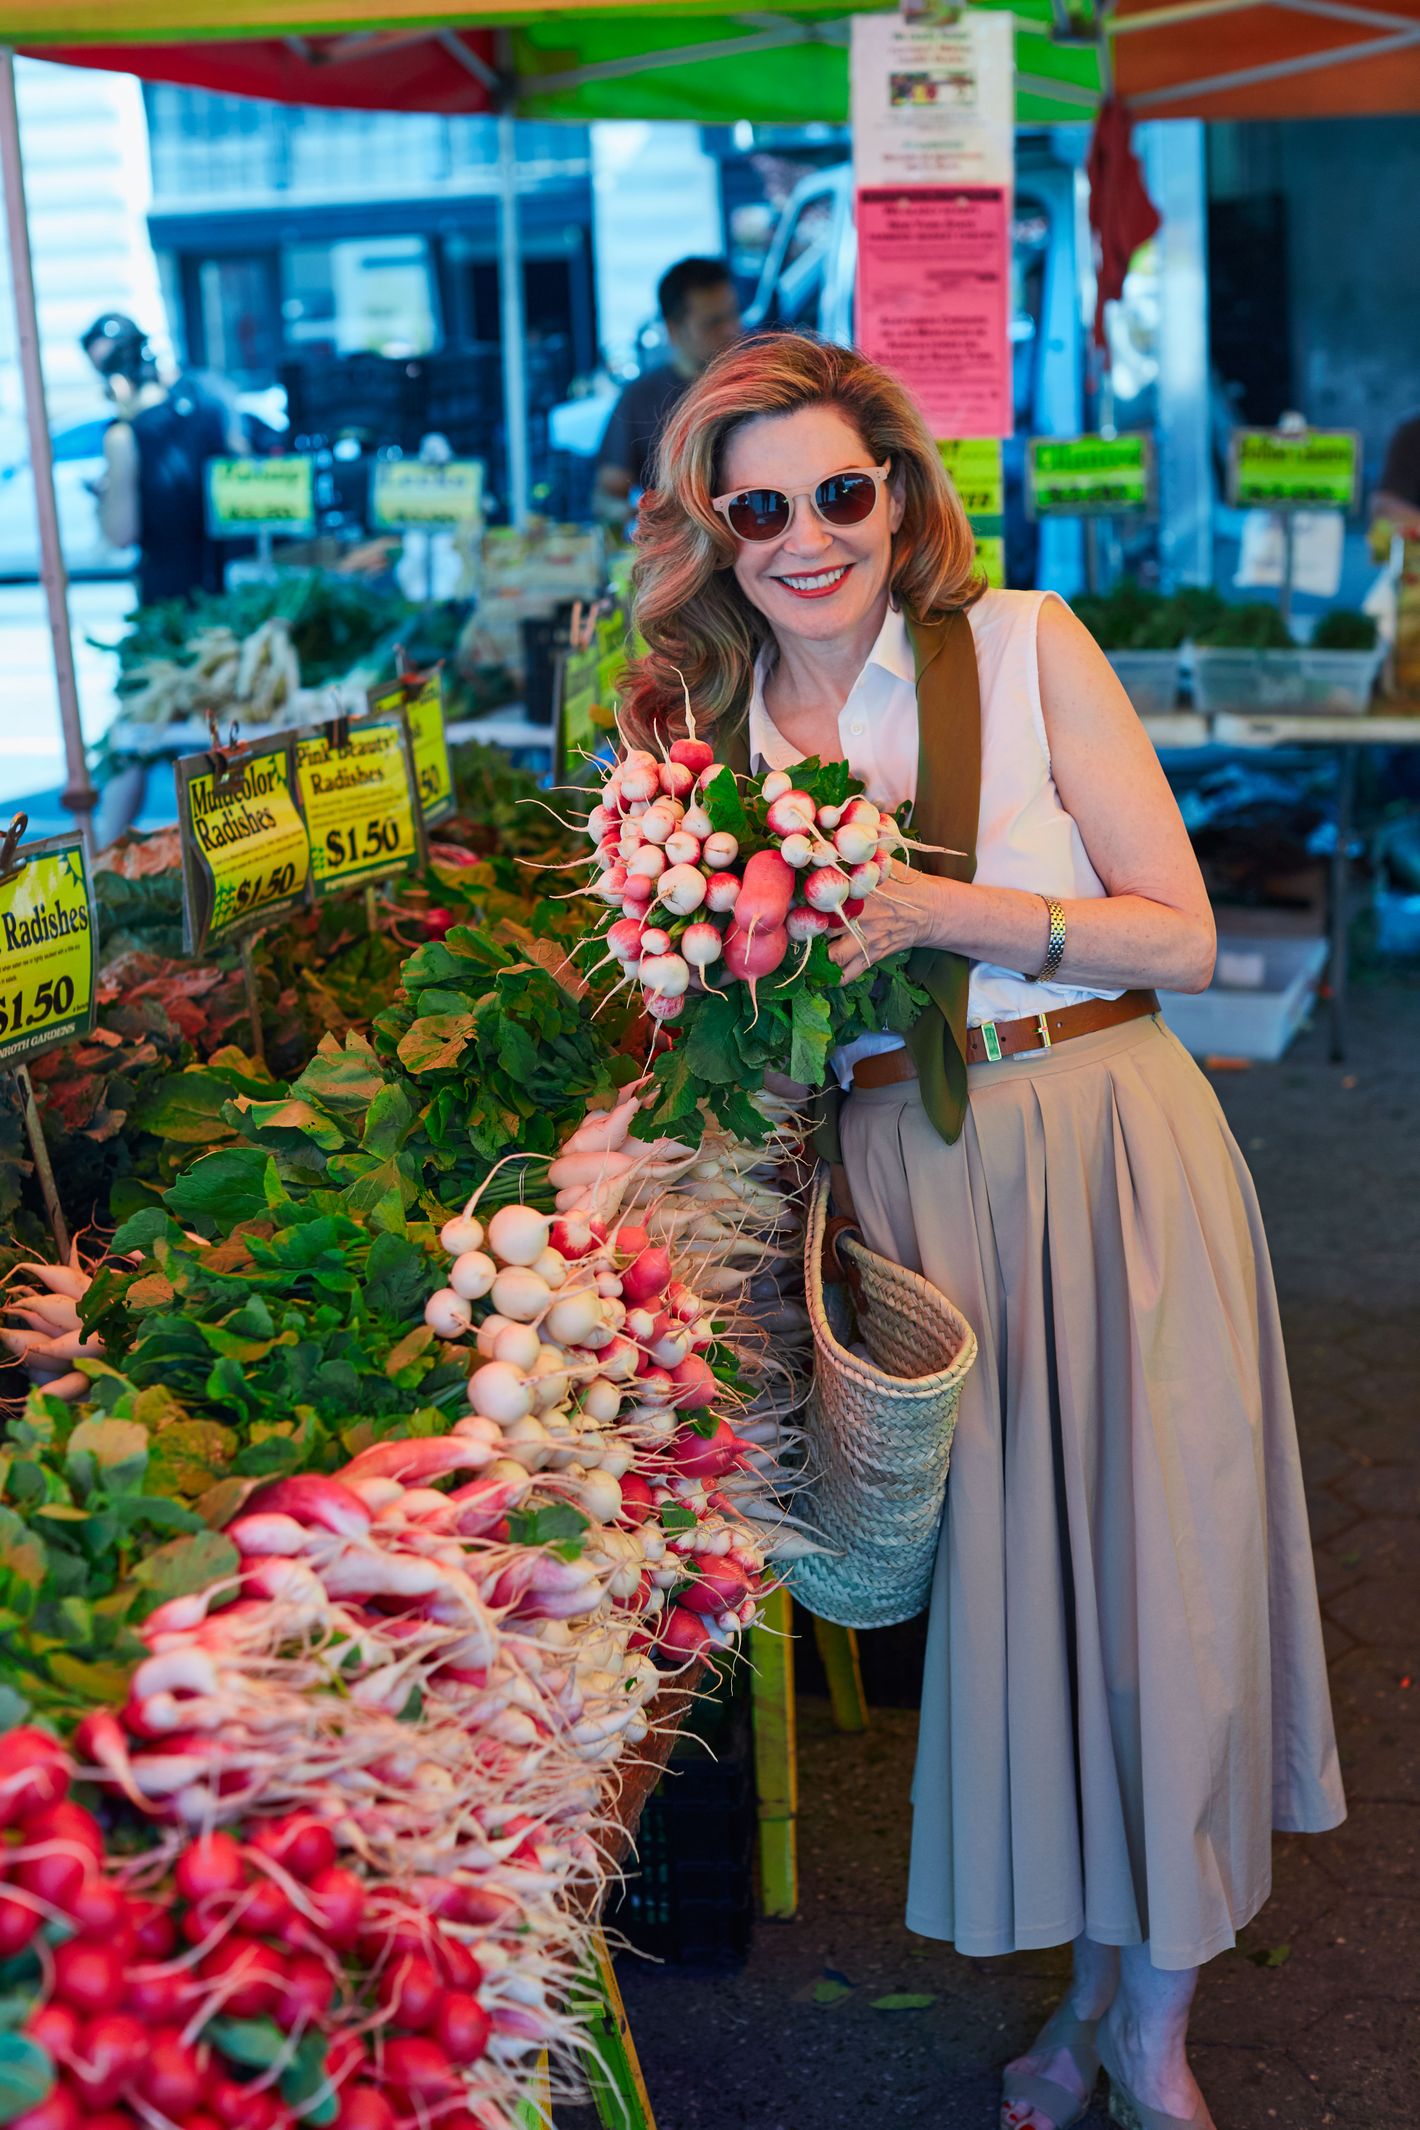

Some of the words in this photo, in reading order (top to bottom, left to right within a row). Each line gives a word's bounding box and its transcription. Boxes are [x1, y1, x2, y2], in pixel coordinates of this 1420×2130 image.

[296, 743, 333, 768] Pink
[311, 766, 384, 796] Radishes
[195, 803, 278, 852] Radishes
[326, 819, 399, 868] $1.50
[232, 862, 295, 914] $1.50
[1, 899, 88, 951] Radishes
[30, 1022, 76, 1047] GARDENS
